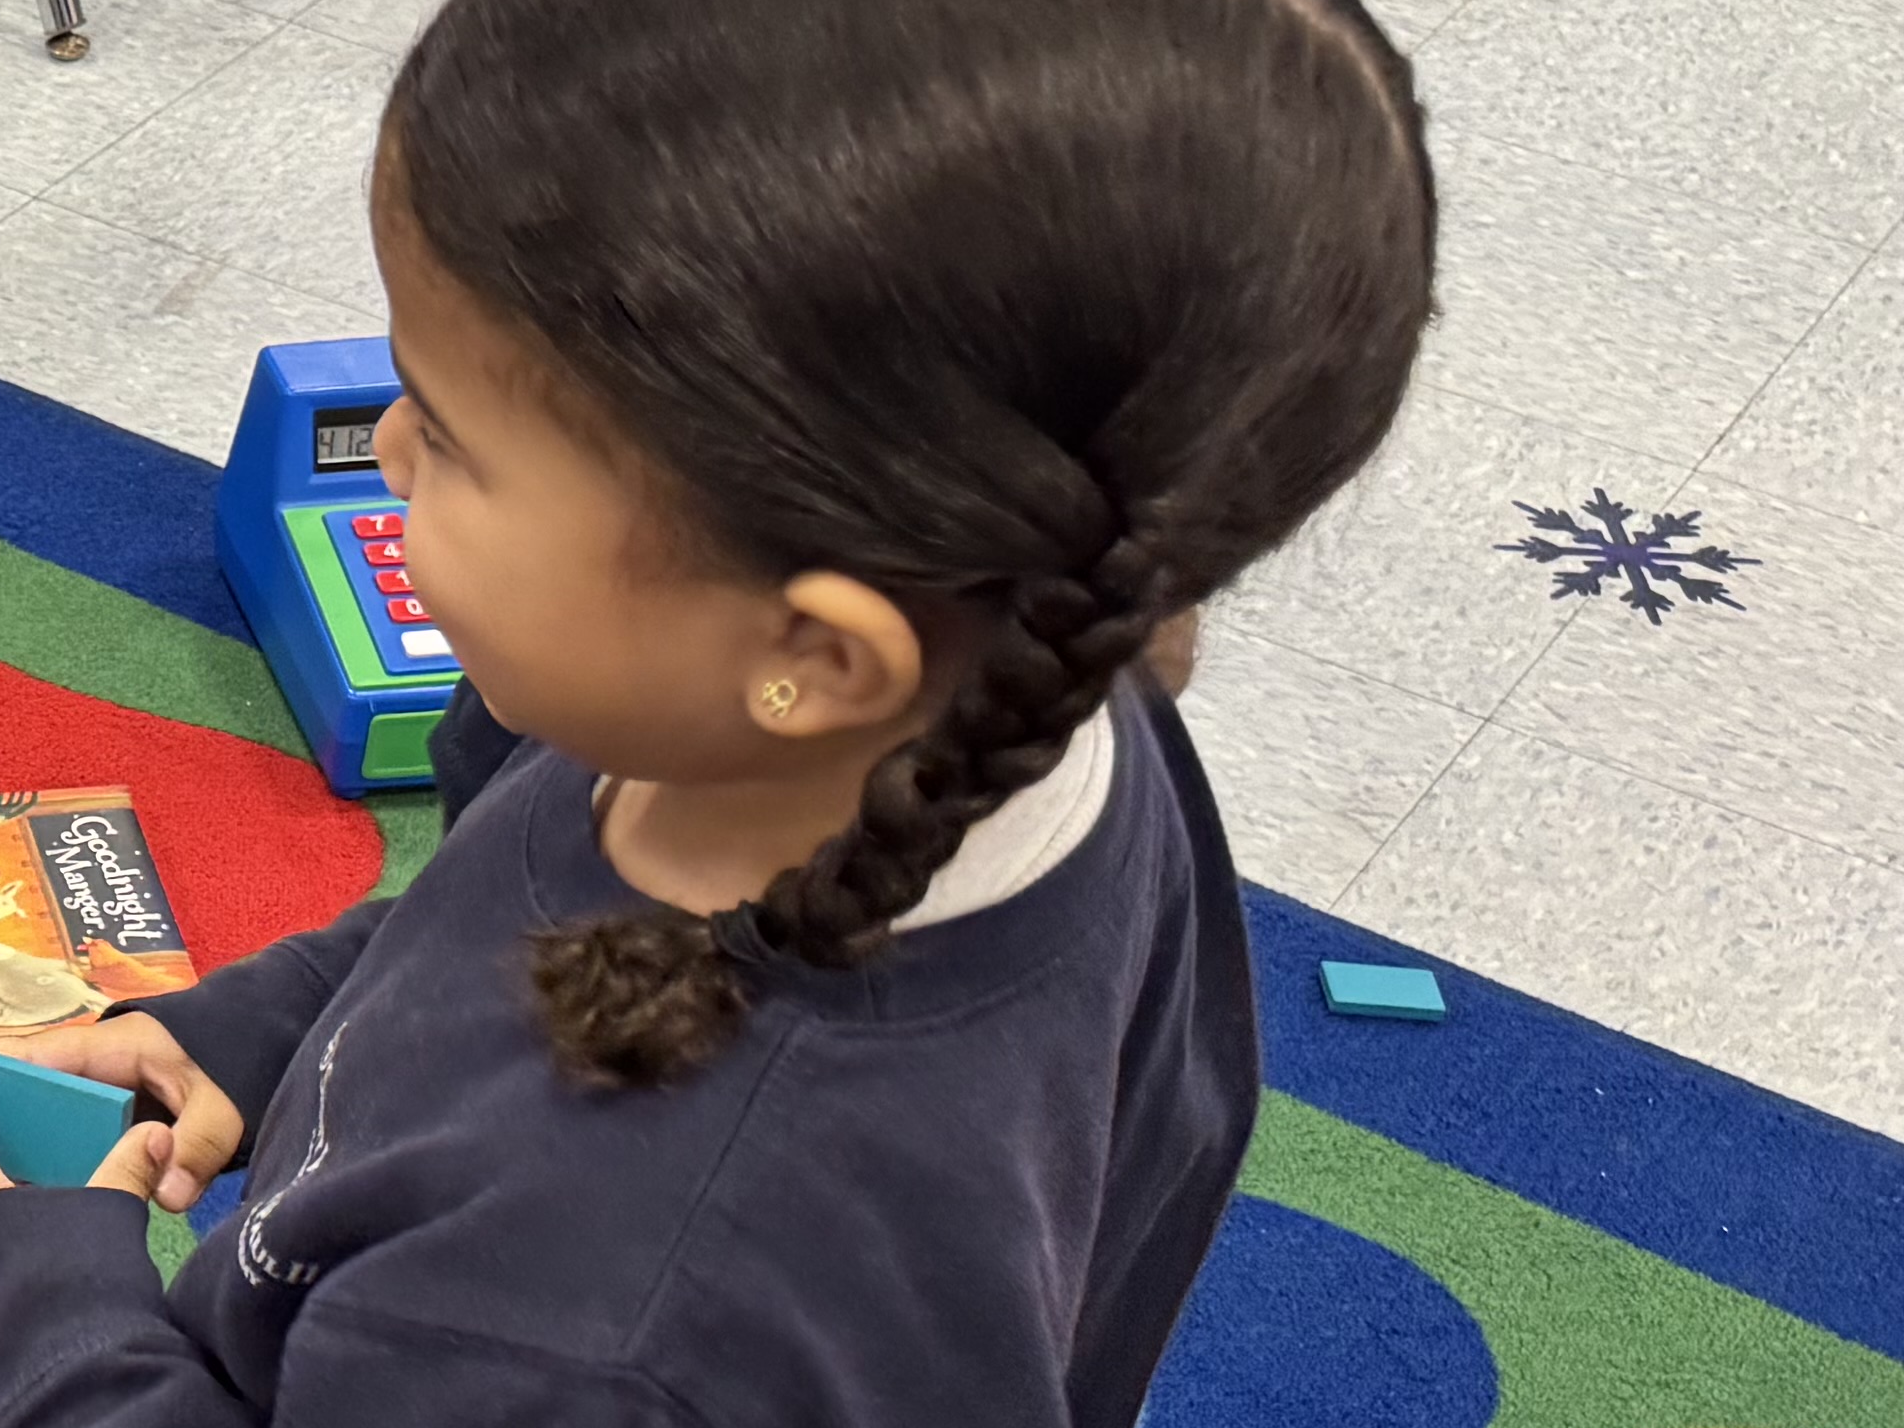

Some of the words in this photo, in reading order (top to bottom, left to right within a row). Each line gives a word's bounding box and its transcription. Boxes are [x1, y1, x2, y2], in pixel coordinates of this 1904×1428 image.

[368, 515, 385, 532] 7
[383, 542, 401, 559] 4
[405, 598, 424, 616] 0
[60, 815, 164, 947] Goodnight
